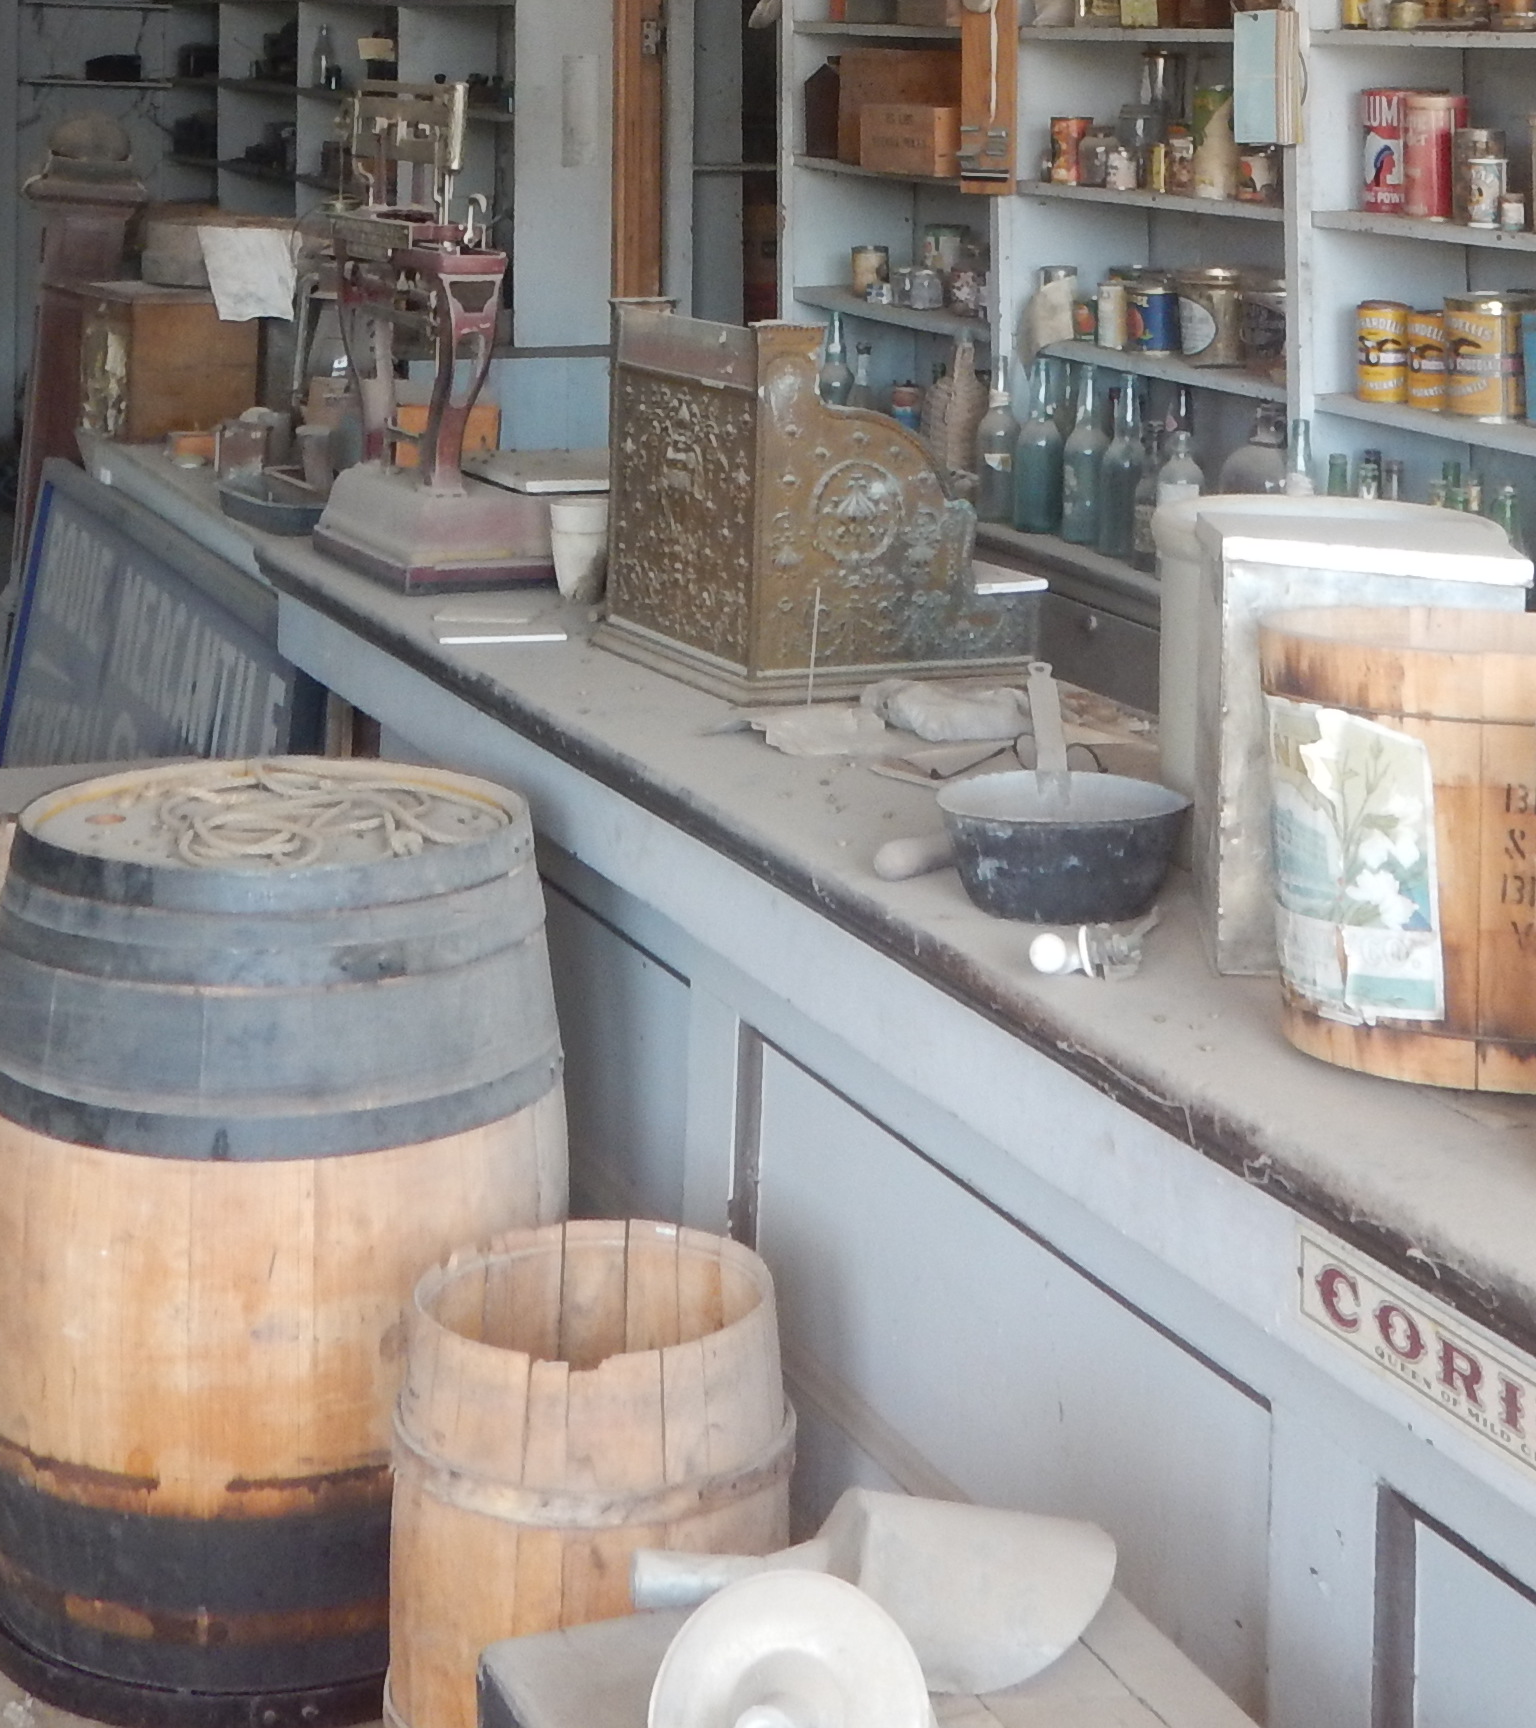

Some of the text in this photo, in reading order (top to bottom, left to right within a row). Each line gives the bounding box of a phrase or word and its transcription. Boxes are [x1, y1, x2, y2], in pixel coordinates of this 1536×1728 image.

[1373, 1345, 1433, 1391] QUEEN
[1440, 1391, 1462, 1408] OF
[1467, 1407, 1512, 1444] MILD
